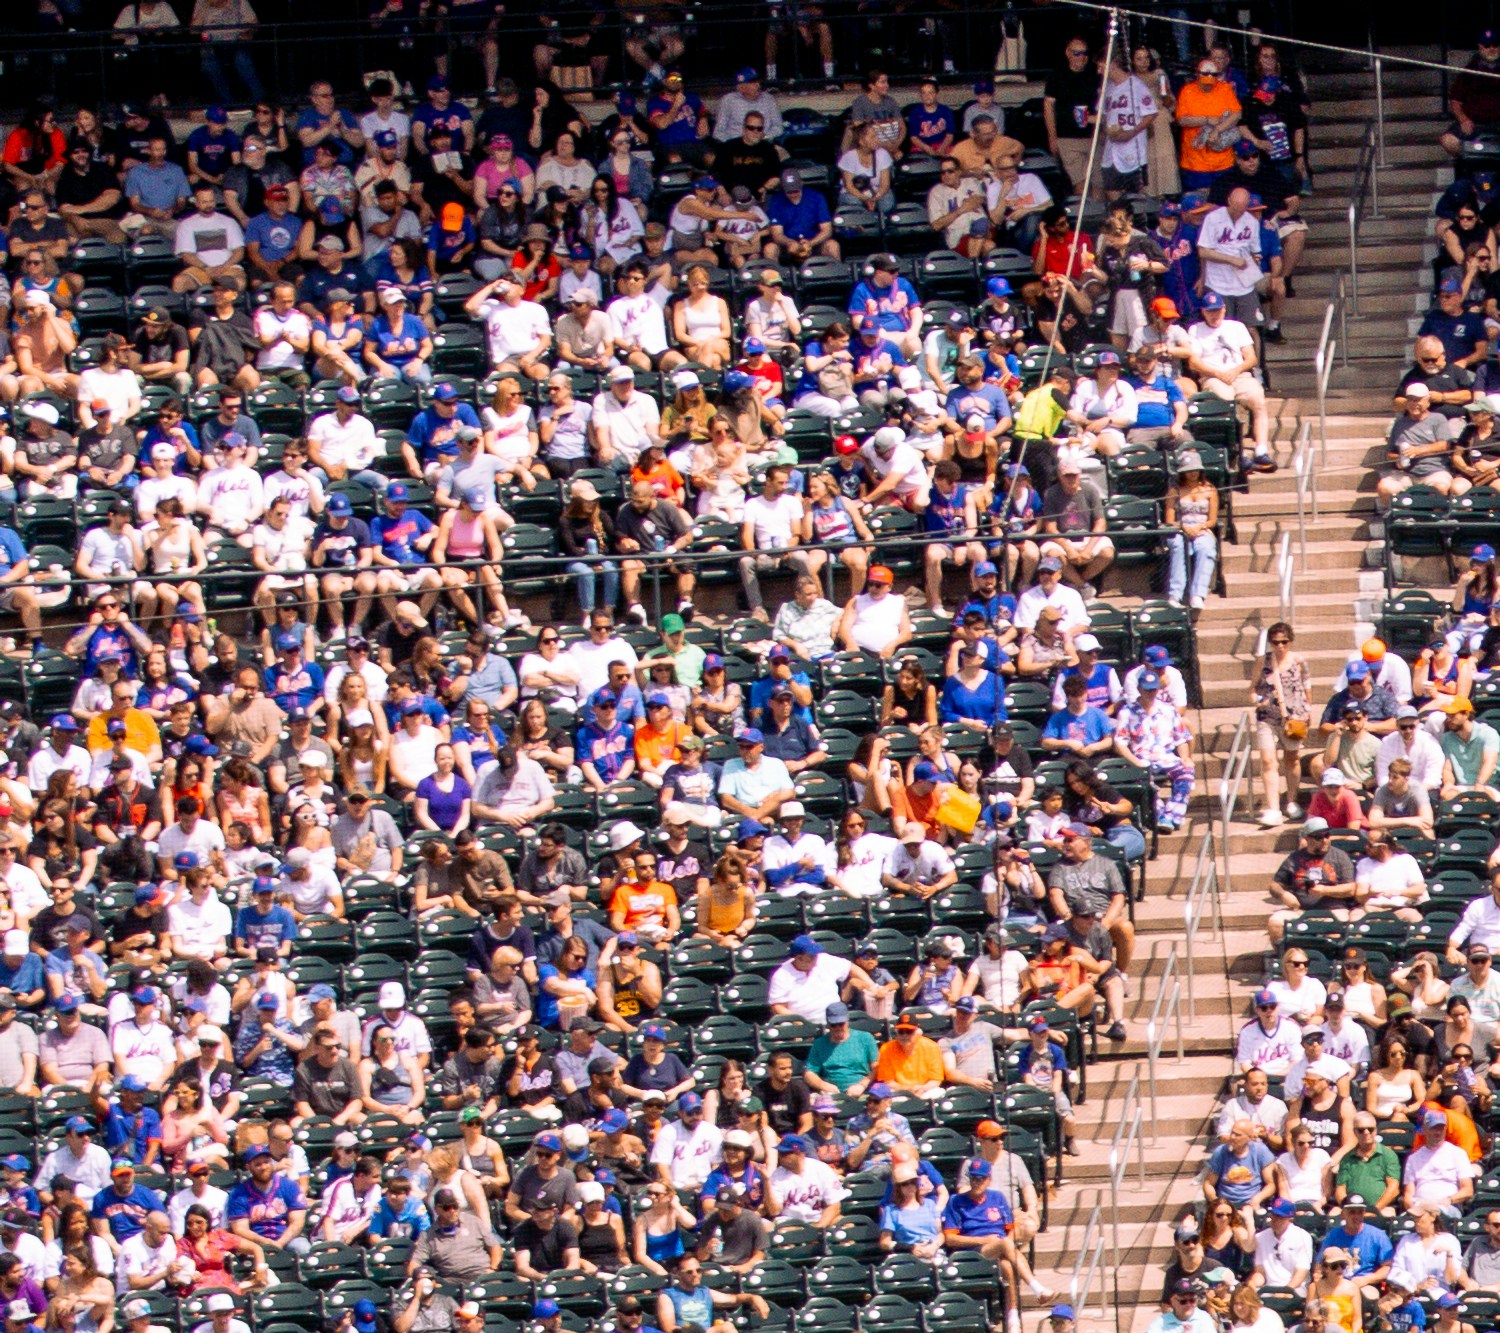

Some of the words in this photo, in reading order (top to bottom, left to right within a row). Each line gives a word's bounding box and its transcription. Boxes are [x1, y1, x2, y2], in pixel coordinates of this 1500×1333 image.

[1218, 228, 1253, 243] Mets
[1256, 1045, 1290, 1061] Mets
[784, 1186, 820, 1207] Mets
